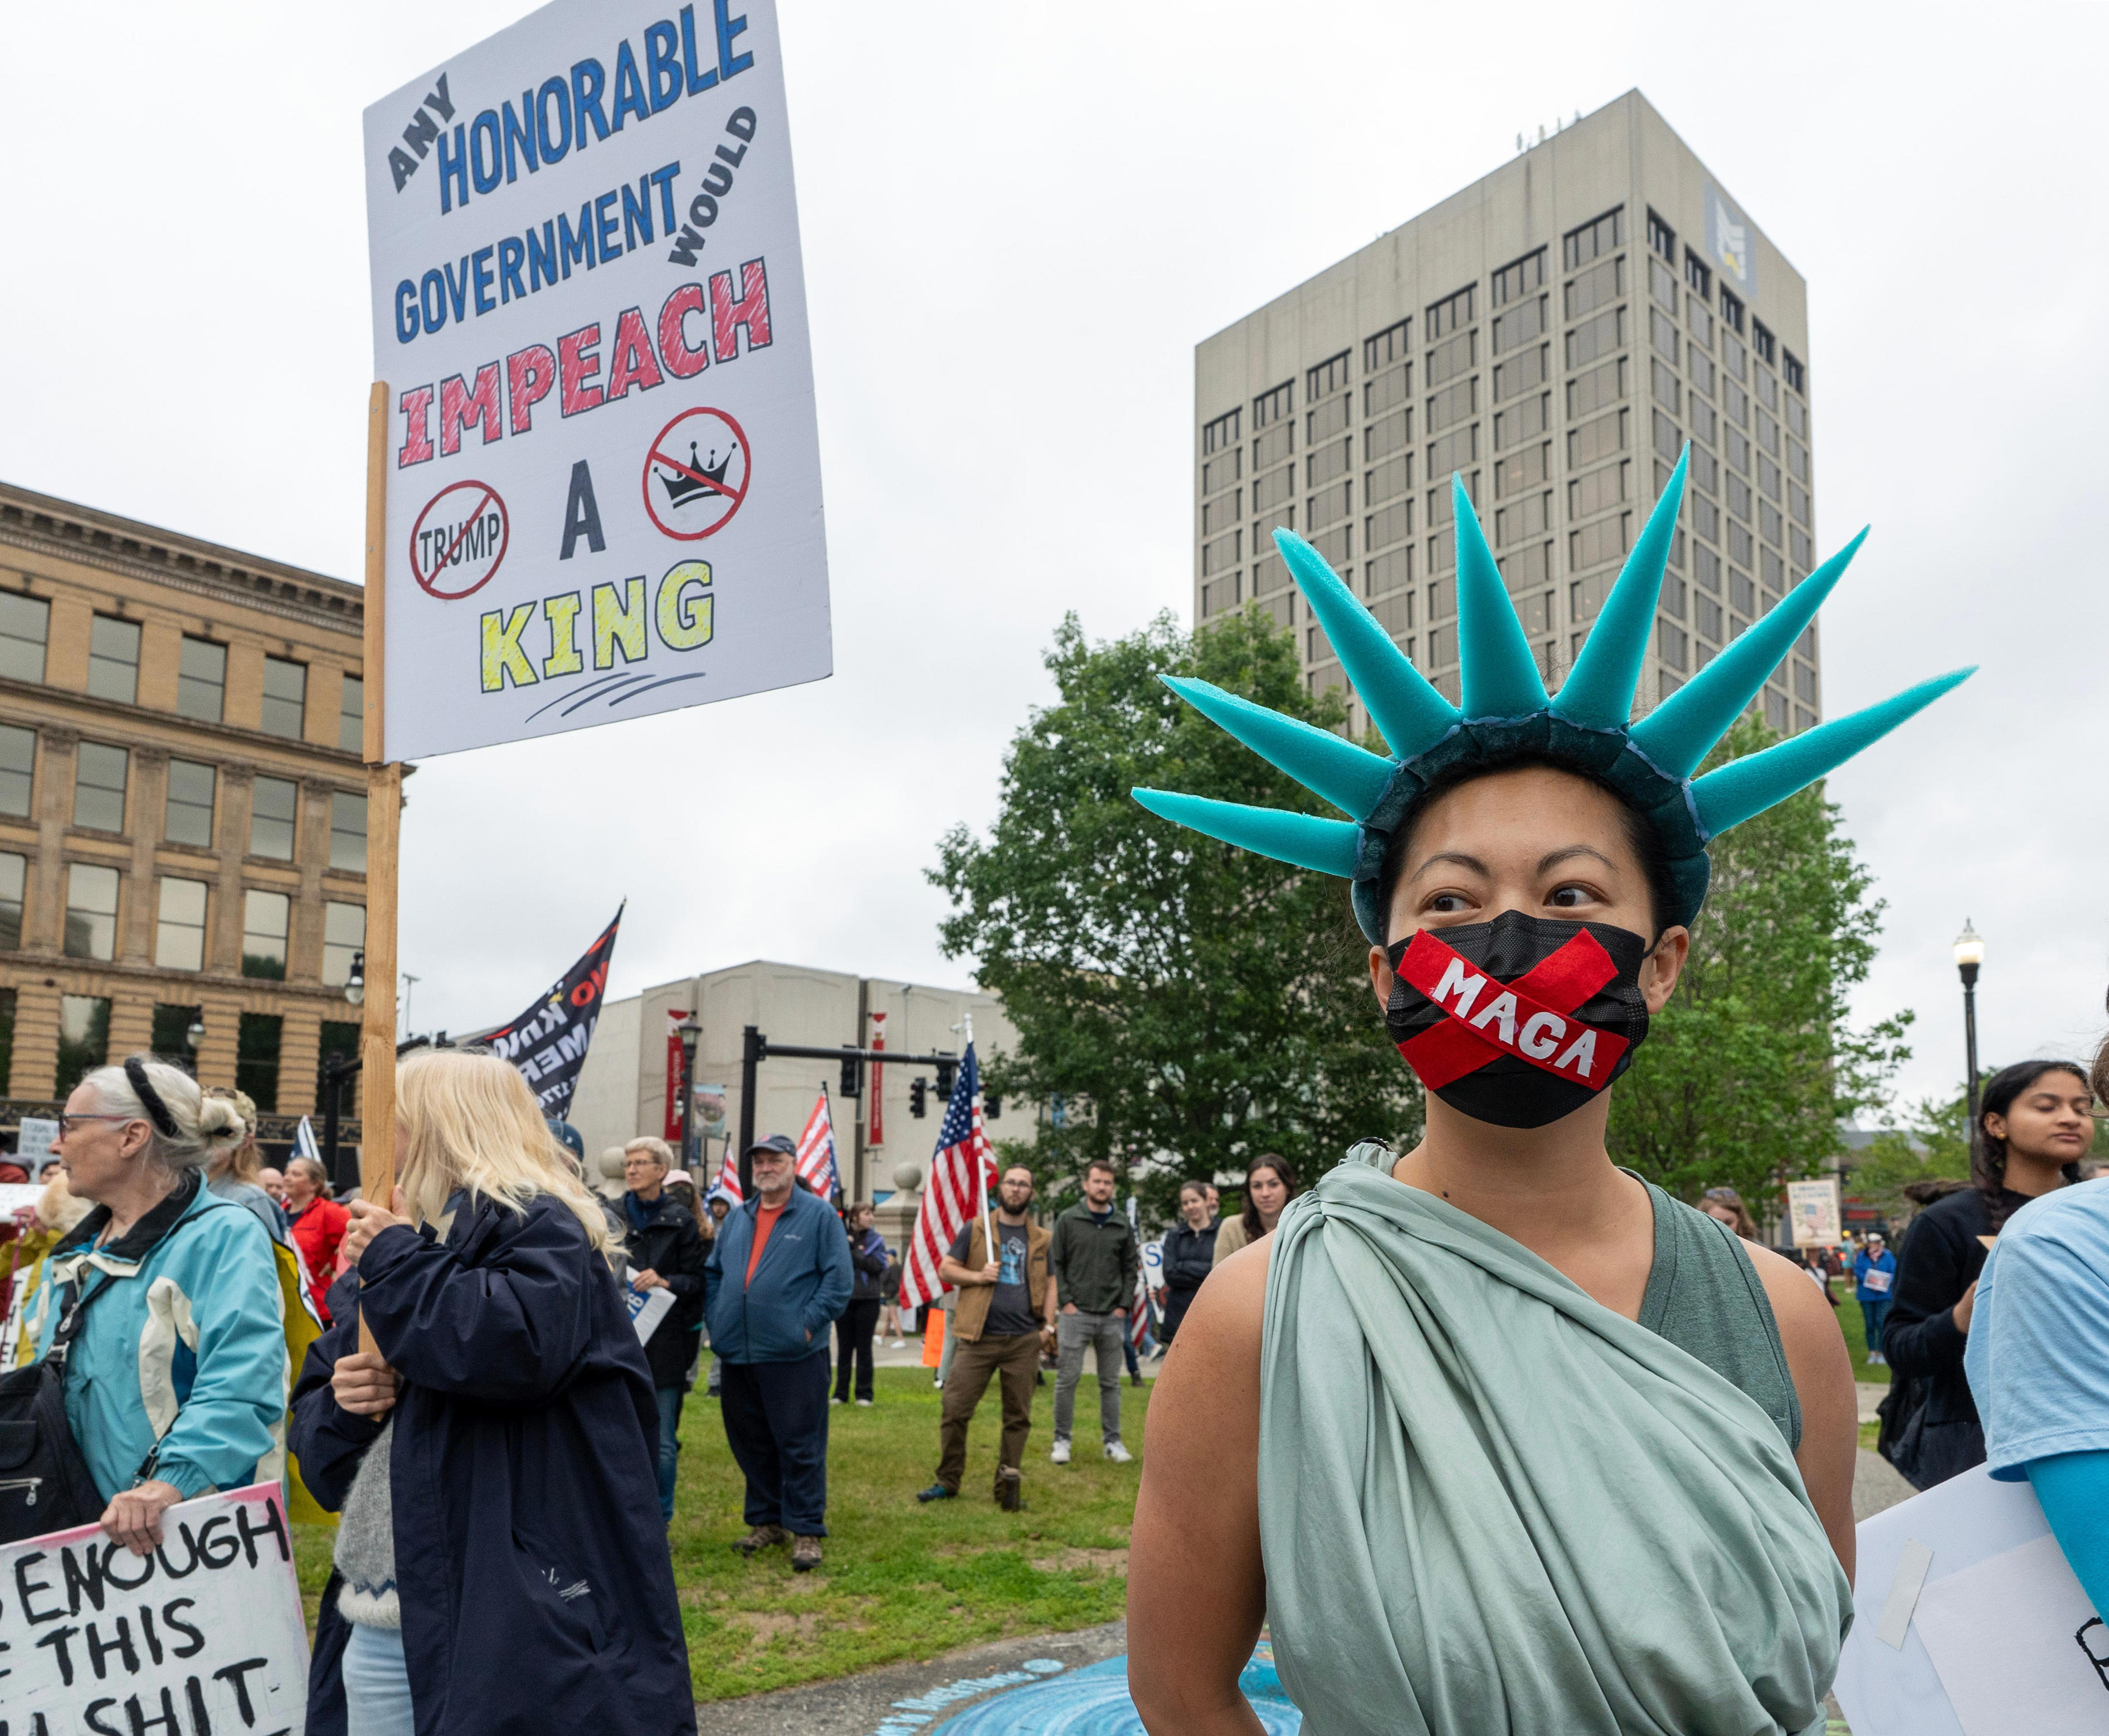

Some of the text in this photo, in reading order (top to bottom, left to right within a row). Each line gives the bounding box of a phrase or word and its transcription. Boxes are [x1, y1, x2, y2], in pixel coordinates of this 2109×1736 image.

[387, 71, 456, 194] ANY
[437, 0, 754, 216] HONORABLE
[668, 105, 757, 267] WOULD
[394, 160, 680, 344] GOVERNMENT
[398, 256, 773, 470] IMPEACH
[419, 513, 500, 573] TRUMP
[559, 459, 607, 560] A
[480, 559, 715, 694] KING
[1430, 957, 1597, 1078] MAGA
[14, 1496, 290, 1626] ENOUGH
[35, 1597, 206, 1687] THIS
